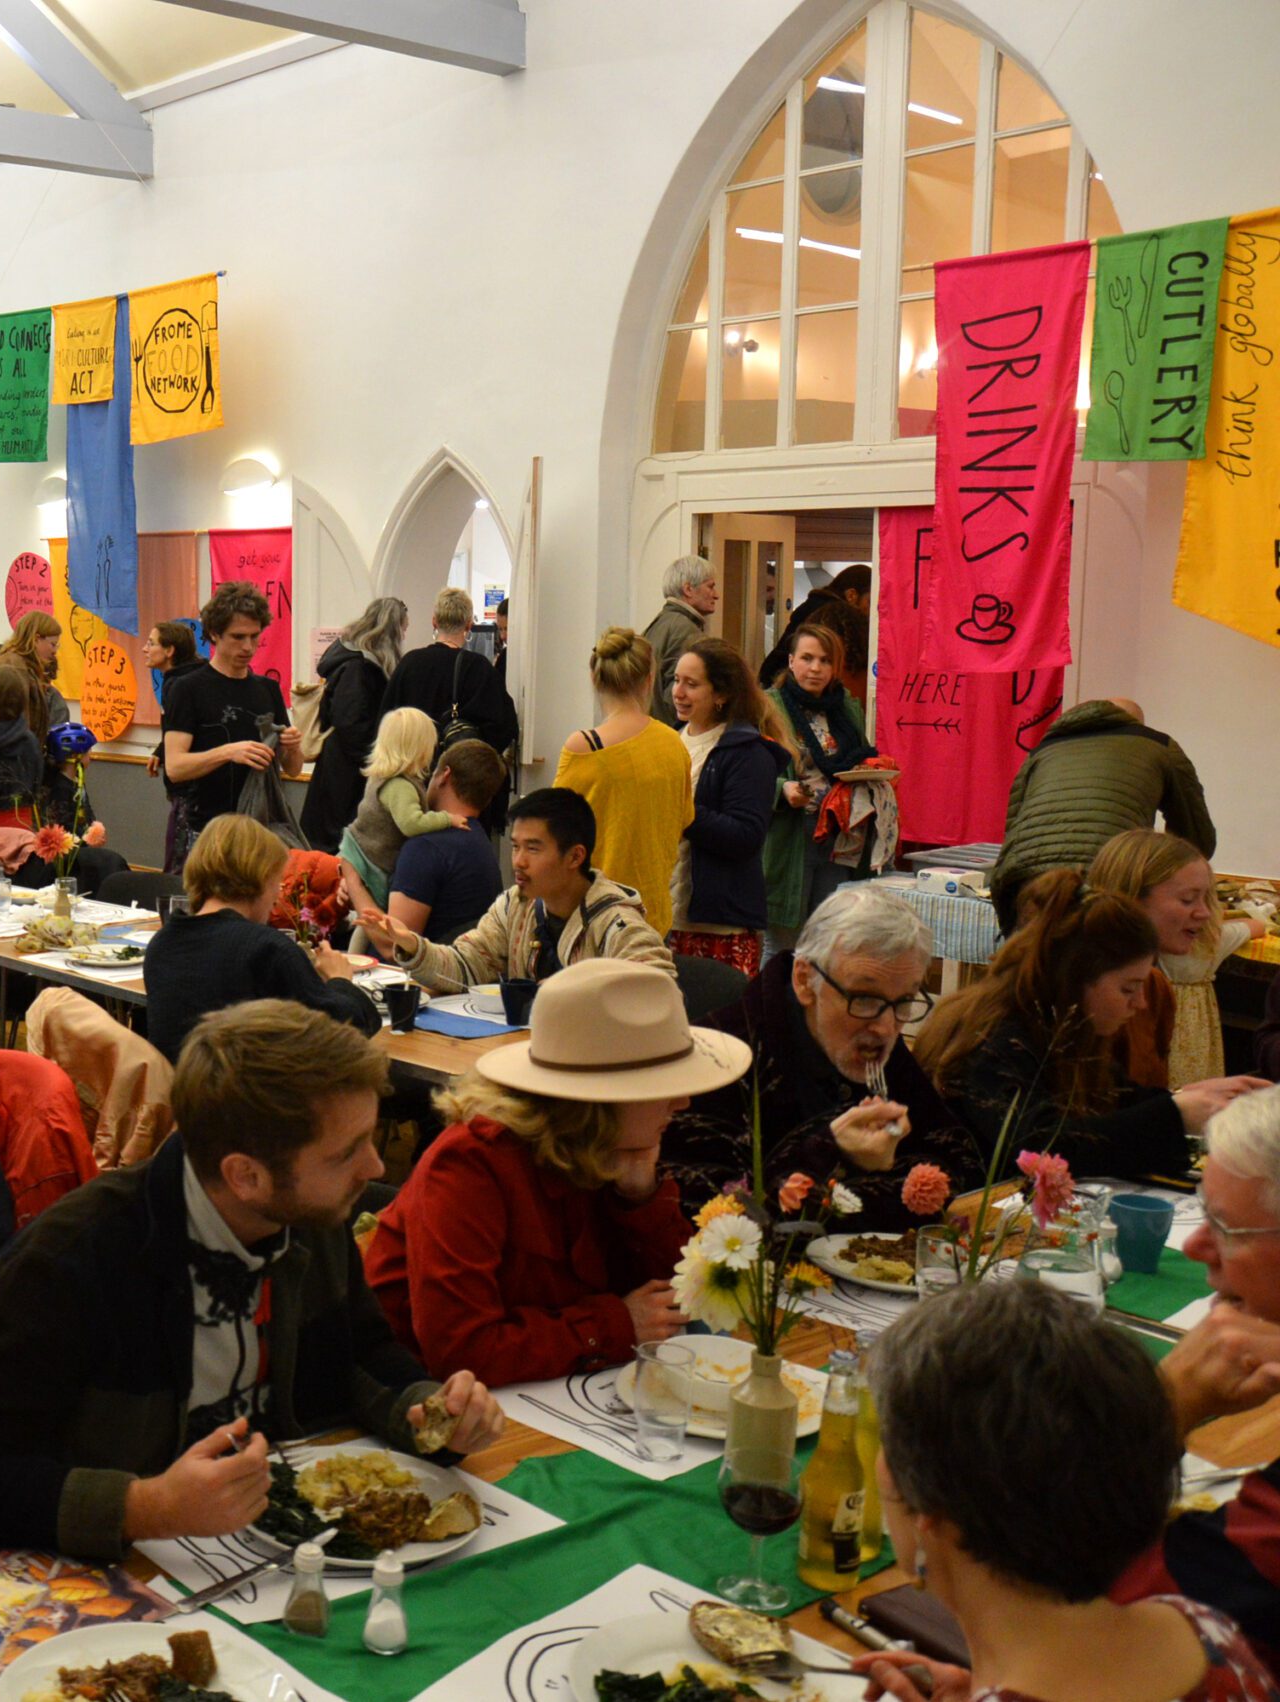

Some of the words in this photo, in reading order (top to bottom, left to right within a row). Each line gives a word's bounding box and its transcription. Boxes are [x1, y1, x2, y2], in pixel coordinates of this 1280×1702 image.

[8, 321, 51, 354] CONNECTS
[154, 320, 193, 345] FROME
[147, 343, 200, 377] FOOD
[1148, 250, 1210, 452] CUTLERY
[12, 358, 27, 379] ALL
[70, 369, 94, 396] ACT
[150, 373, 199, 394] NETWORK
[959, 304, 1043, 563] DRINKS
[1216, 383, 1260, 486] think
[14, 555, 37, 573] STEP
[39, 563, 48, 578] 2
[236, 549, 257, 569] get
[88, 645, 115, 669] STEP
[114, 656, 126, 675] 3
[898, 672, 968, 706] HERE
